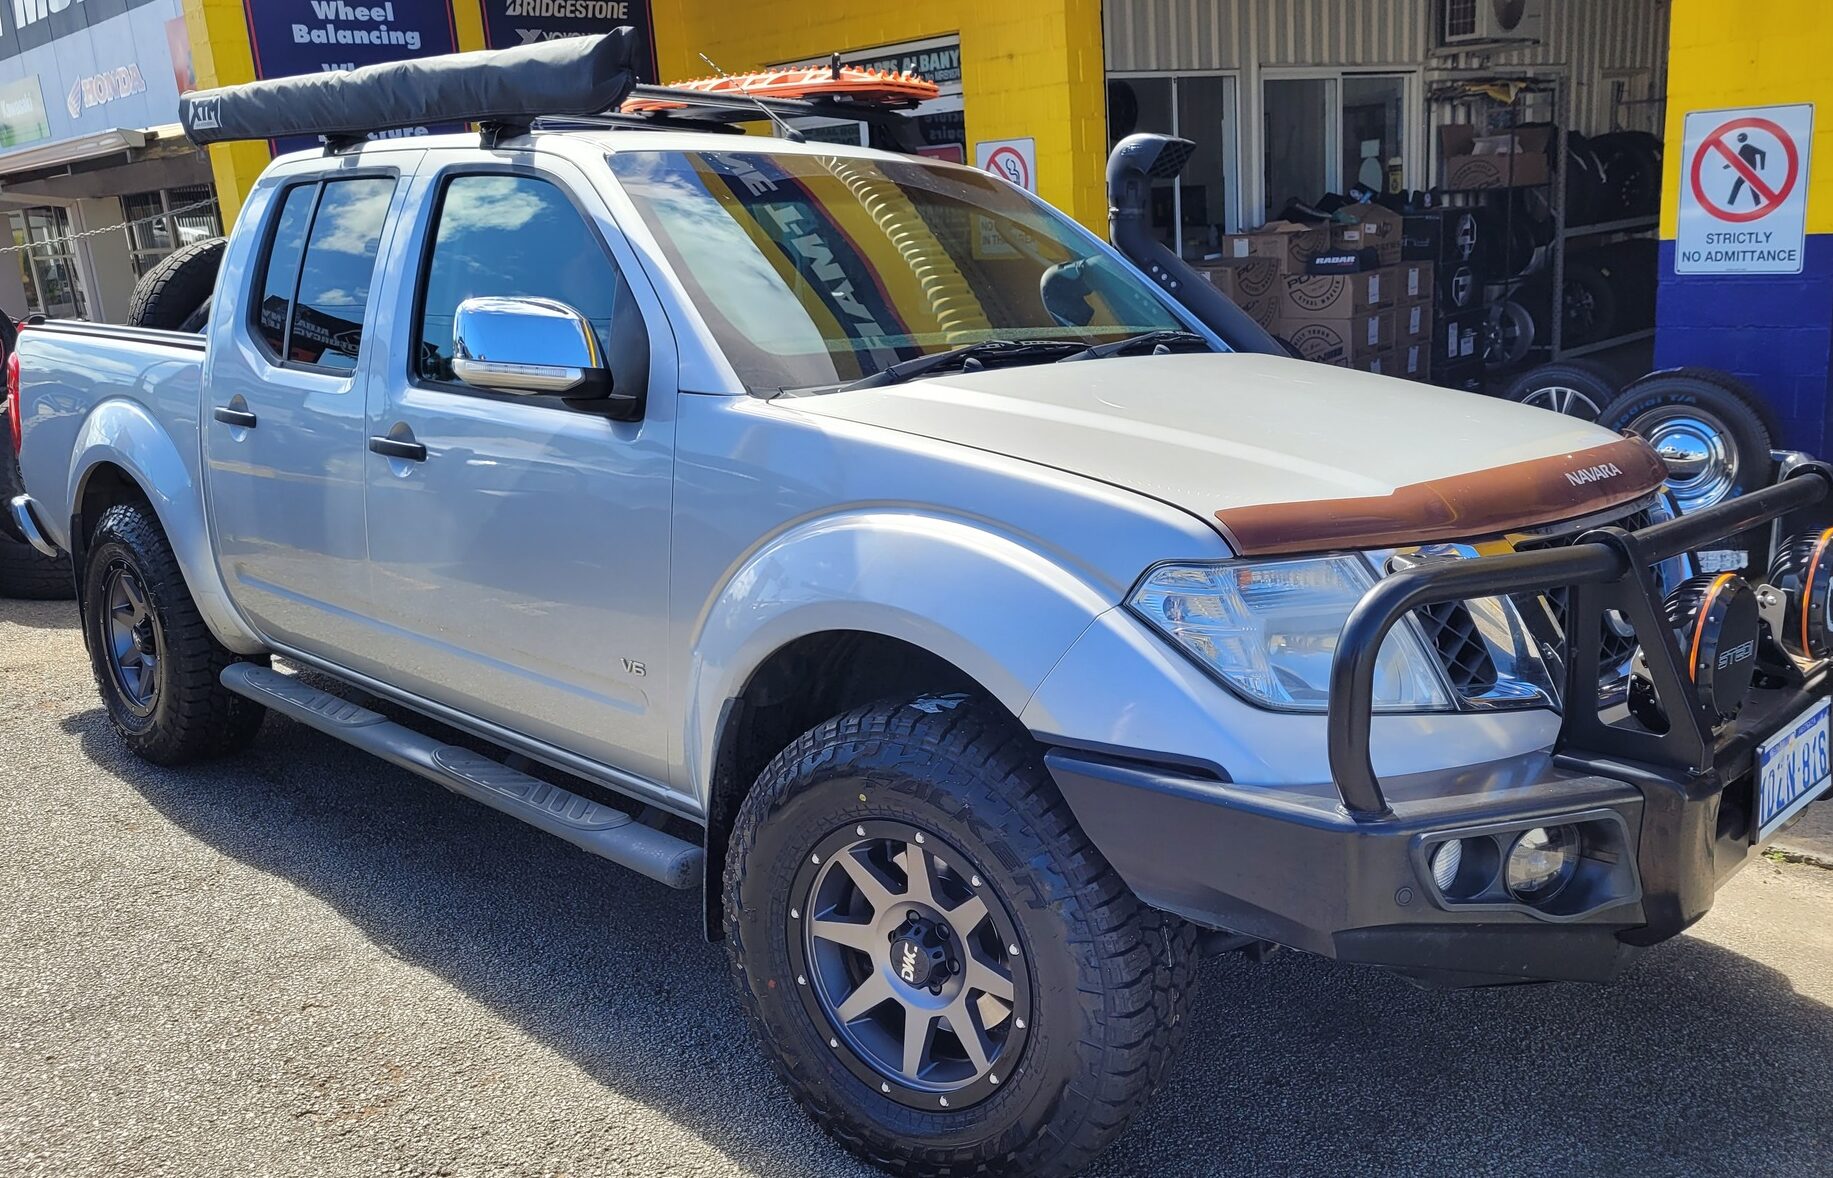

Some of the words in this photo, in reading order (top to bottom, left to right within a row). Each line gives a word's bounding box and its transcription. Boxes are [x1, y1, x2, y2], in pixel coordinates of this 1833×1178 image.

[311, 1, 394, 22] Wheel
[506, 0, 628, 20] BRIDGESTONE
[292, 24, 421, 50] Balancing
[902, 49, 959, 71] ALBANY
[82, 64, 146, 108] HONDA
[1705, 231, 1773, 244] STRICTLY
[1315, 256, 1356, 265] RADAR
[1681, 251, 1701, 262] NO
[1704, 249, 1796, 262] ADMITTANCE
[1564, 462, 1623, 487] NAVARA
[620, 657, 647, 677] V6
